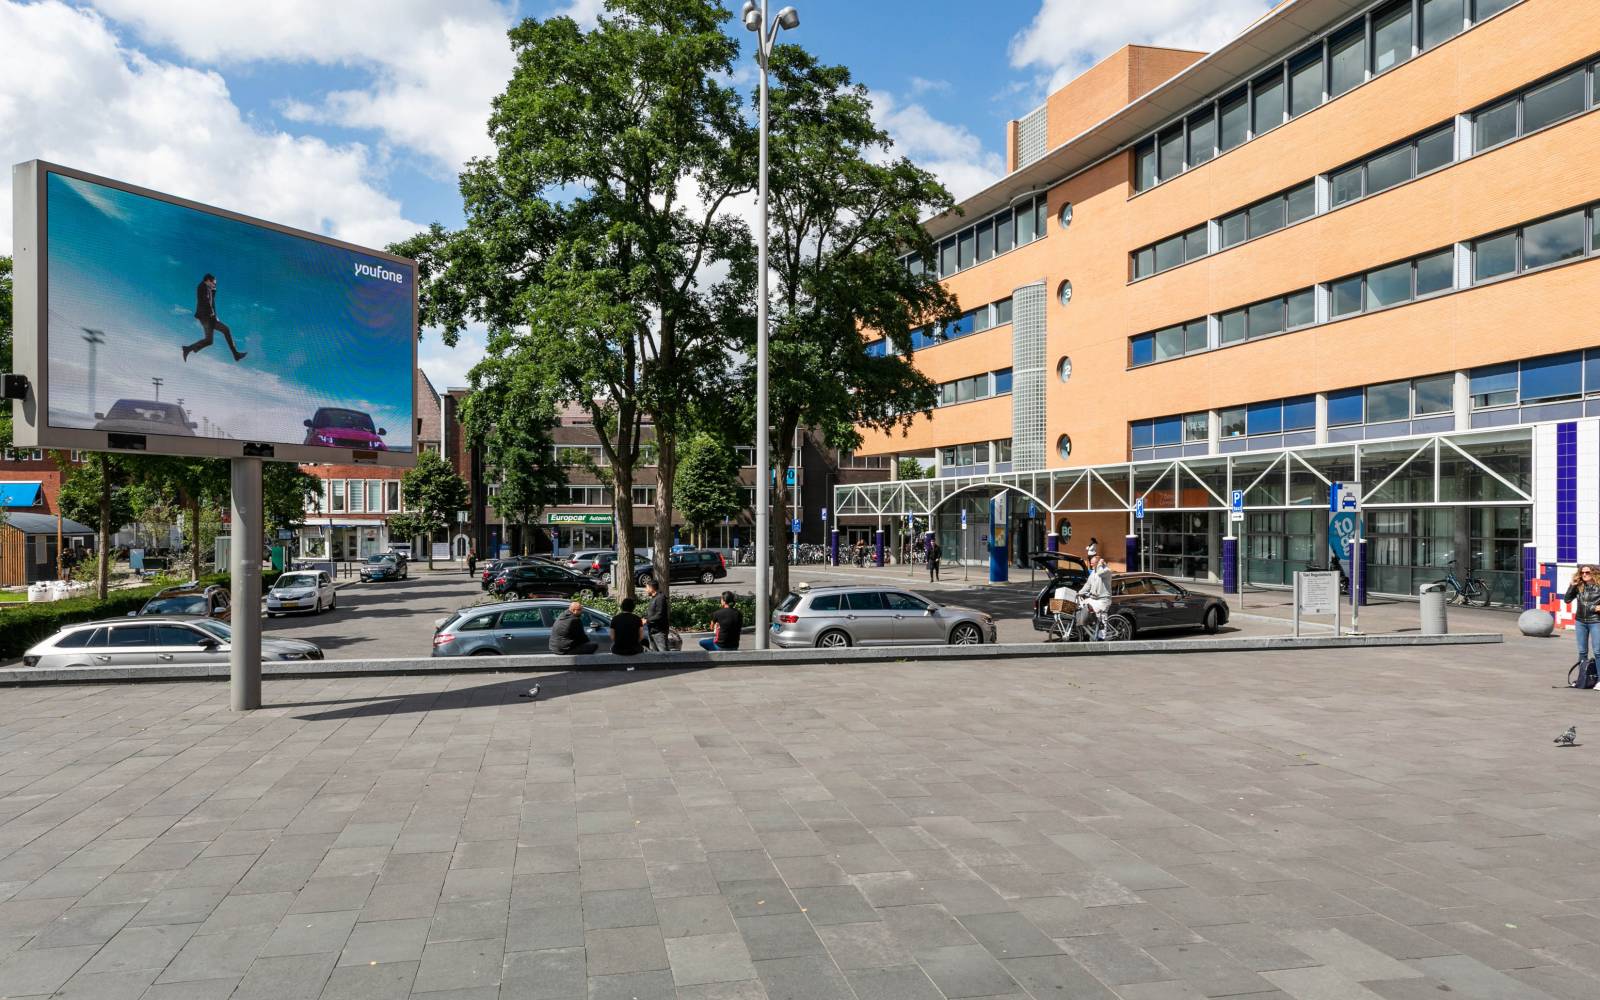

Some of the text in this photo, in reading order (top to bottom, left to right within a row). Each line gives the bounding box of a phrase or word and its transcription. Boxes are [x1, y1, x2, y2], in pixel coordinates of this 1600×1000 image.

[354, 263, 403, 284] youfone
[1064, 288, 1072, 299] 3
[1064, 364, 1071, 375] 2
[1234, 492, 1241, 504] P
